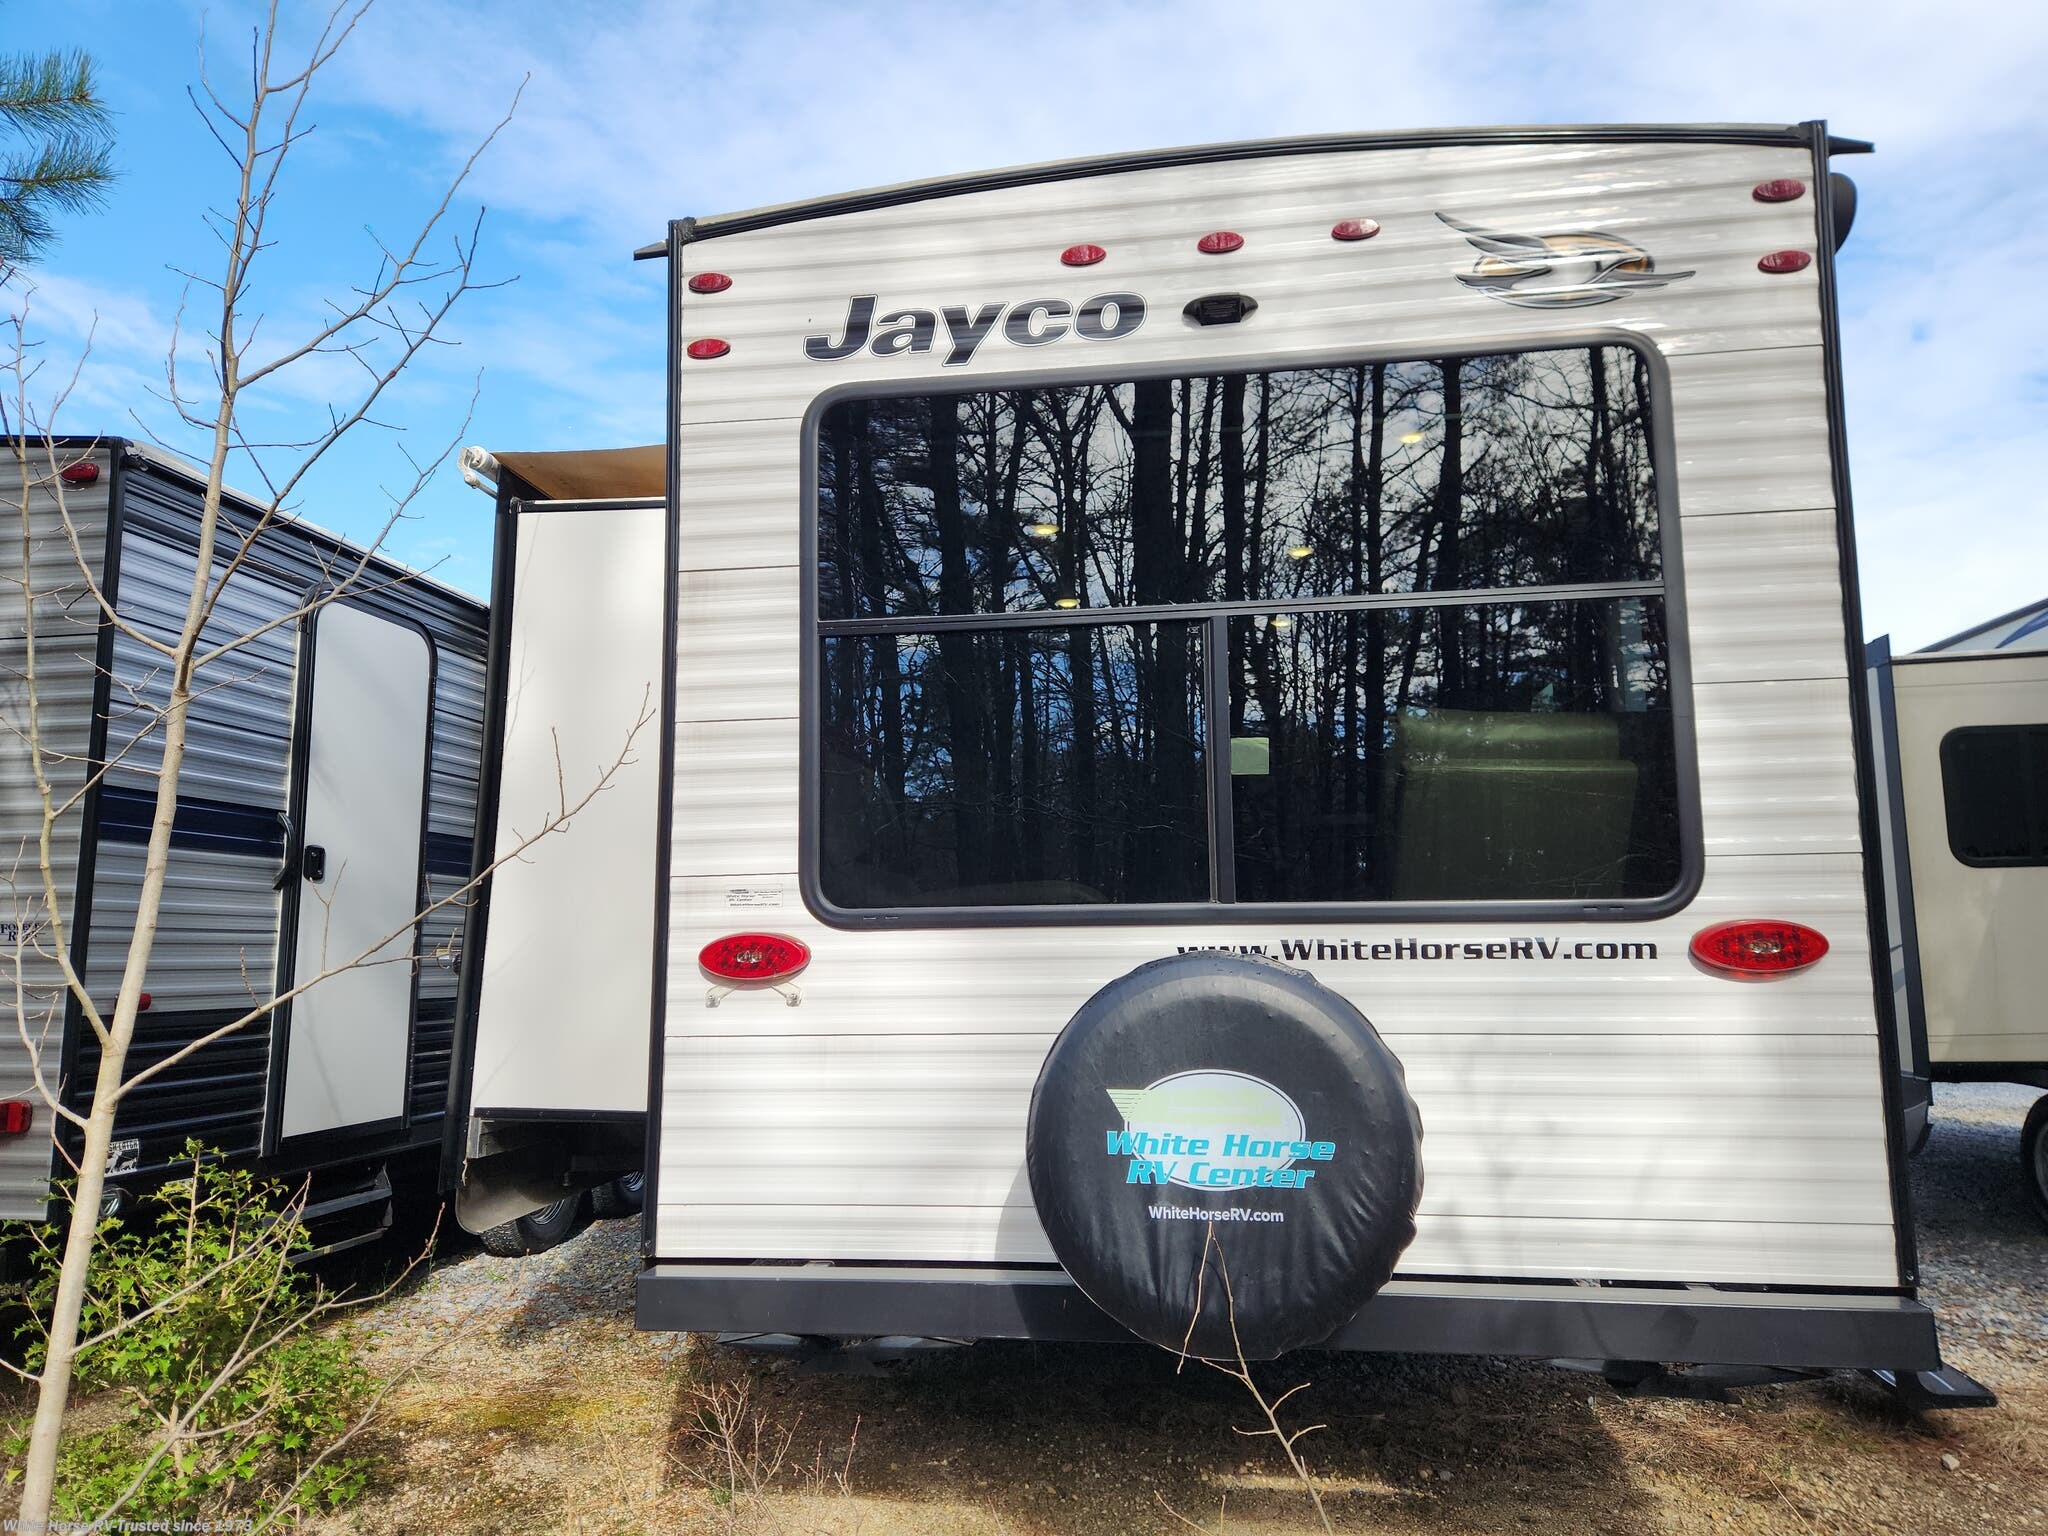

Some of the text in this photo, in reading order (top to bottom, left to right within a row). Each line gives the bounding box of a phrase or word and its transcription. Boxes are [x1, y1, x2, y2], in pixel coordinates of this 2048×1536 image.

[802, 291, 1149, 367] Jayco
[1106, 1130, 1336, 1161] White Horse
[1126, 1159, 1316, 1189] RV Center
[1148, 1205, 1284, 1223] WhiteHorseRV.com
